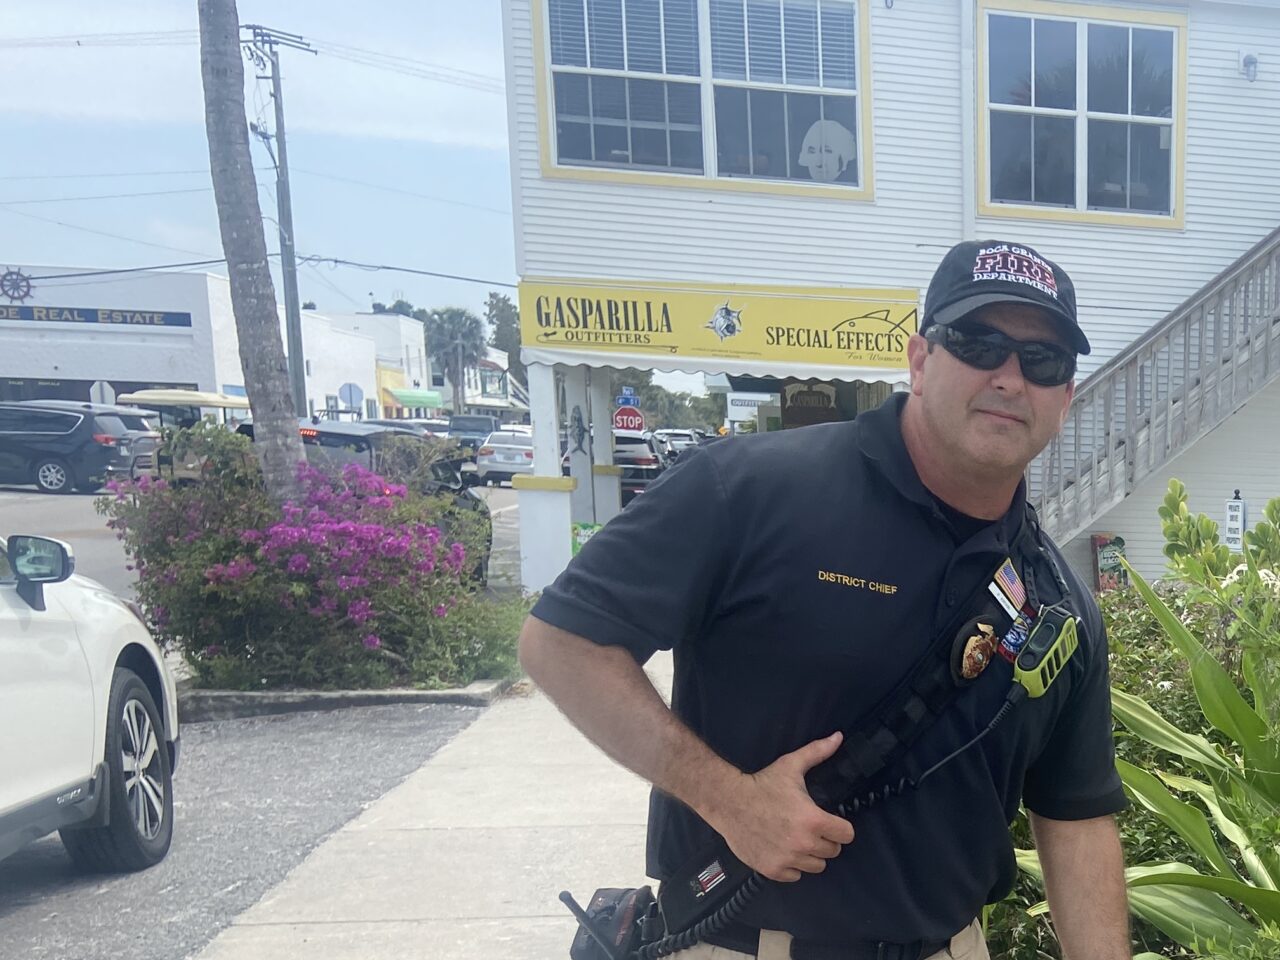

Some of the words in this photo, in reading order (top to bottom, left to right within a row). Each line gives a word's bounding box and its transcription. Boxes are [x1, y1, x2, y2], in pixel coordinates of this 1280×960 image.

[973, 251, 1058, 292] FIRE
[979, 245, 1009, 255] BOCA
[1011, 246, 1053, 272] GRANDE
[972, 273, 1058, 300] DEPARTMENT
[33, 306, 85, 321] REAL
[97, 310, 165, 325] ESTATE
[536, 295, 673, 333] GASPARILLA
[564, 330, 651, 344] OUTFITTERS
[766, 326, 832, 349] SPECIAL
[836, 330, 904, 353] EFFECTS
[616, 415, 642, 428] STOP
[818, 570, 866, 588] DISTRICT
[868, 582, 898, 594] CHIEF
